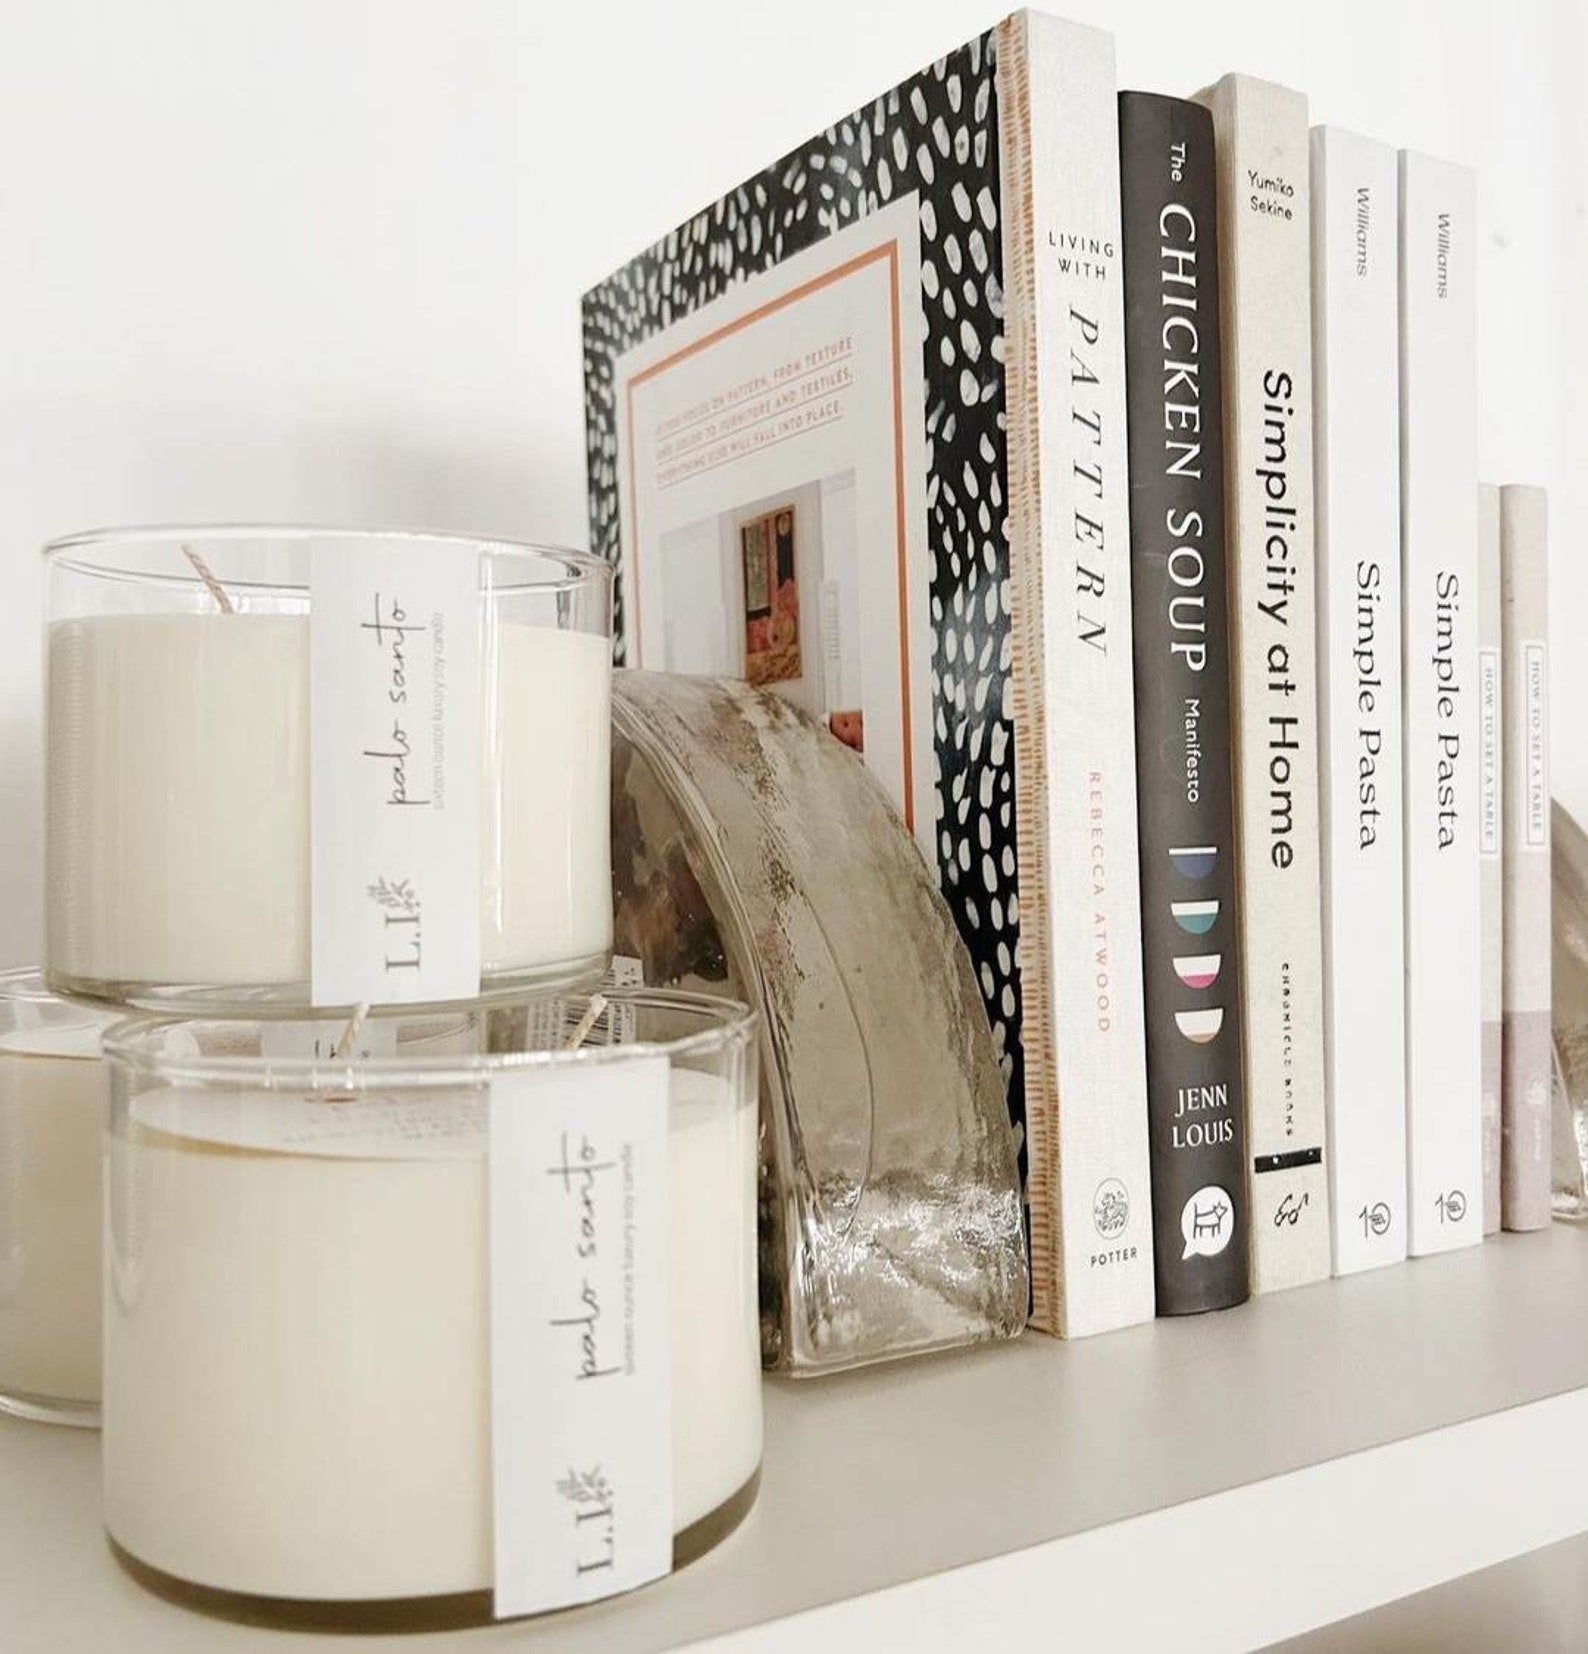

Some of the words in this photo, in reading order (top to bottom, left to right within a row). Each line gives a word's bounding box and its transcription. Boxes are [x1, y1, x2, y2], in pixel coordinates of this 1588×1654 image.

[1170, 141, 1186, 182] The
[1248, 169, 1295, 199] Yumiko
[1250, 195, 1293, 221] Sekine
[1356, 186, 1370, 277] Williams
[1048, 230, 1115, 259] LIVING
[1057, 257, 1107, 281] WITH
[1436, 213, 1450, 299] Williams
[1159, 203, 1202, 479] CHICKEN
[1069, 302, 1107, 656] PATTERN
[1256, 369, 1298, 626] Simplicity
[1166, 508, 1206, 673] SOUP
[361, 592, 427, 704] santo
[432, 612, 445, 655] candle
[1353, 560, 1382, 713] Simple
[1432, 571, 1460, 718] Simple
[434, 656, 447, 682] soy
[1267, 644, 1296, 696] at
[1484, 667, 1494, 706] HOW
[1531, 660, 1541, 698] HOW
[1484, 715, 1494, 736] TO
[1531, 708, 1541, 729] TO
[362, 719, 431, 805] palo
[1184, 697, 1202, 803] Manifesto
[1484, 741, 1494, 769] SET
[1531, 735, 1541, 761] SET
[1268, 716, 1300, 870] Home
[1359, 728, 1382, 851] Pasta
[1437, 733, 1460, 851] Pasta
[1484, 791, 1494, 840] TABLE
[1531, 784, 1541, 831] TABLE
[1088, 770, 1106, 896] REBECCA
[1093, 910, 1111, 1034] ATWOOD
[1174, 1083, 1229, 1118] JENN
[1172, 1118, 1234, 1148] LOUIS
[546, 1130, 616, 1258] santo
[1090, 1247, 1138, 1267] POTTER
[549, 1276, 622, 1382] palo
